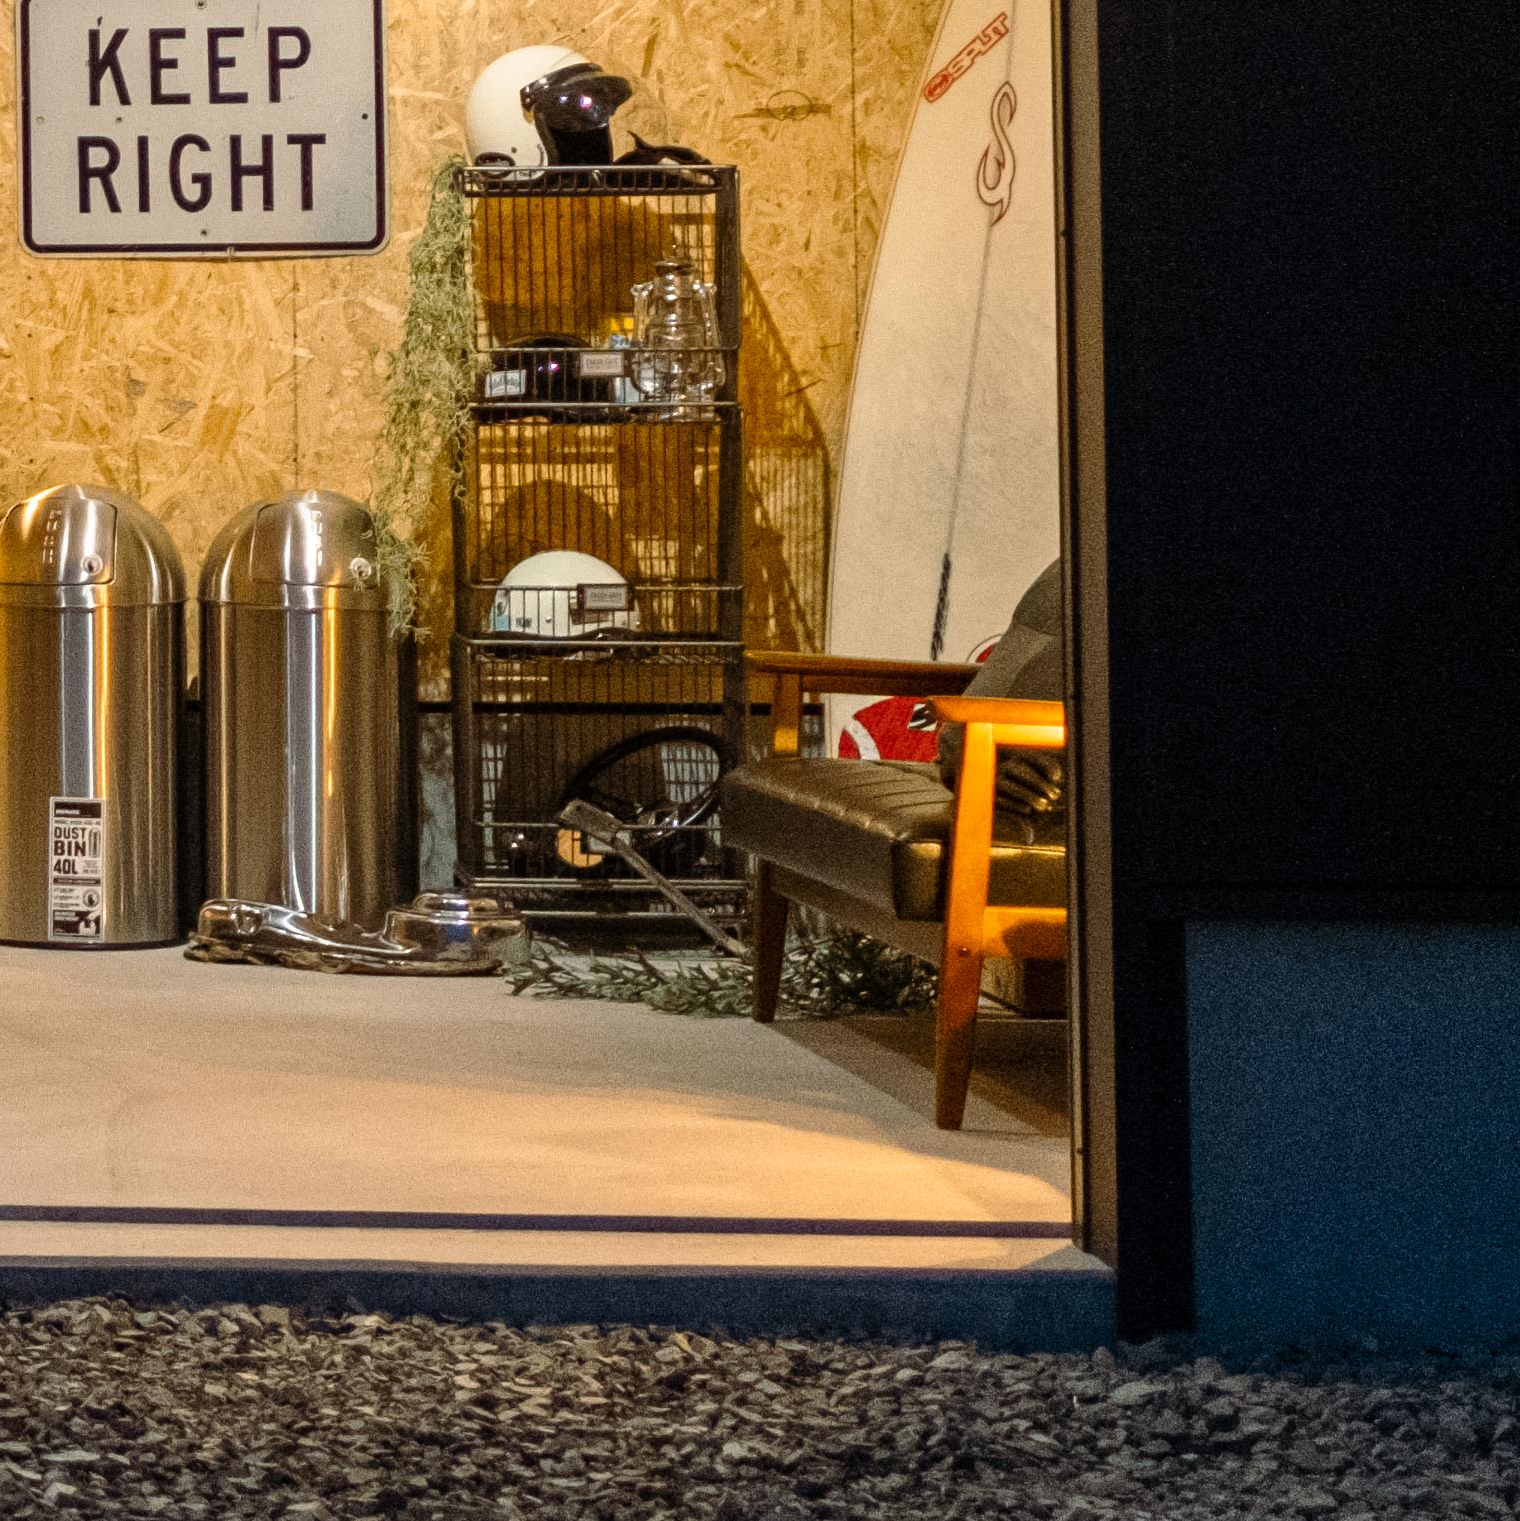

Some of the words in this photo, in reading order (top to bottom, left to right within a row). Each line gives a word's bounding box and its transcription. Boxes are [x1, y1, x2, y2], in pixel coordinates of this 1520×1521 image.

[87, 26, 312, 106] KEEP
[77, 132, 327, 214] RIGHT
[54, 827, 87, 840] DUST
[54, 841, 86, 857] BIN
[53, 858, 78, 875] 40L
